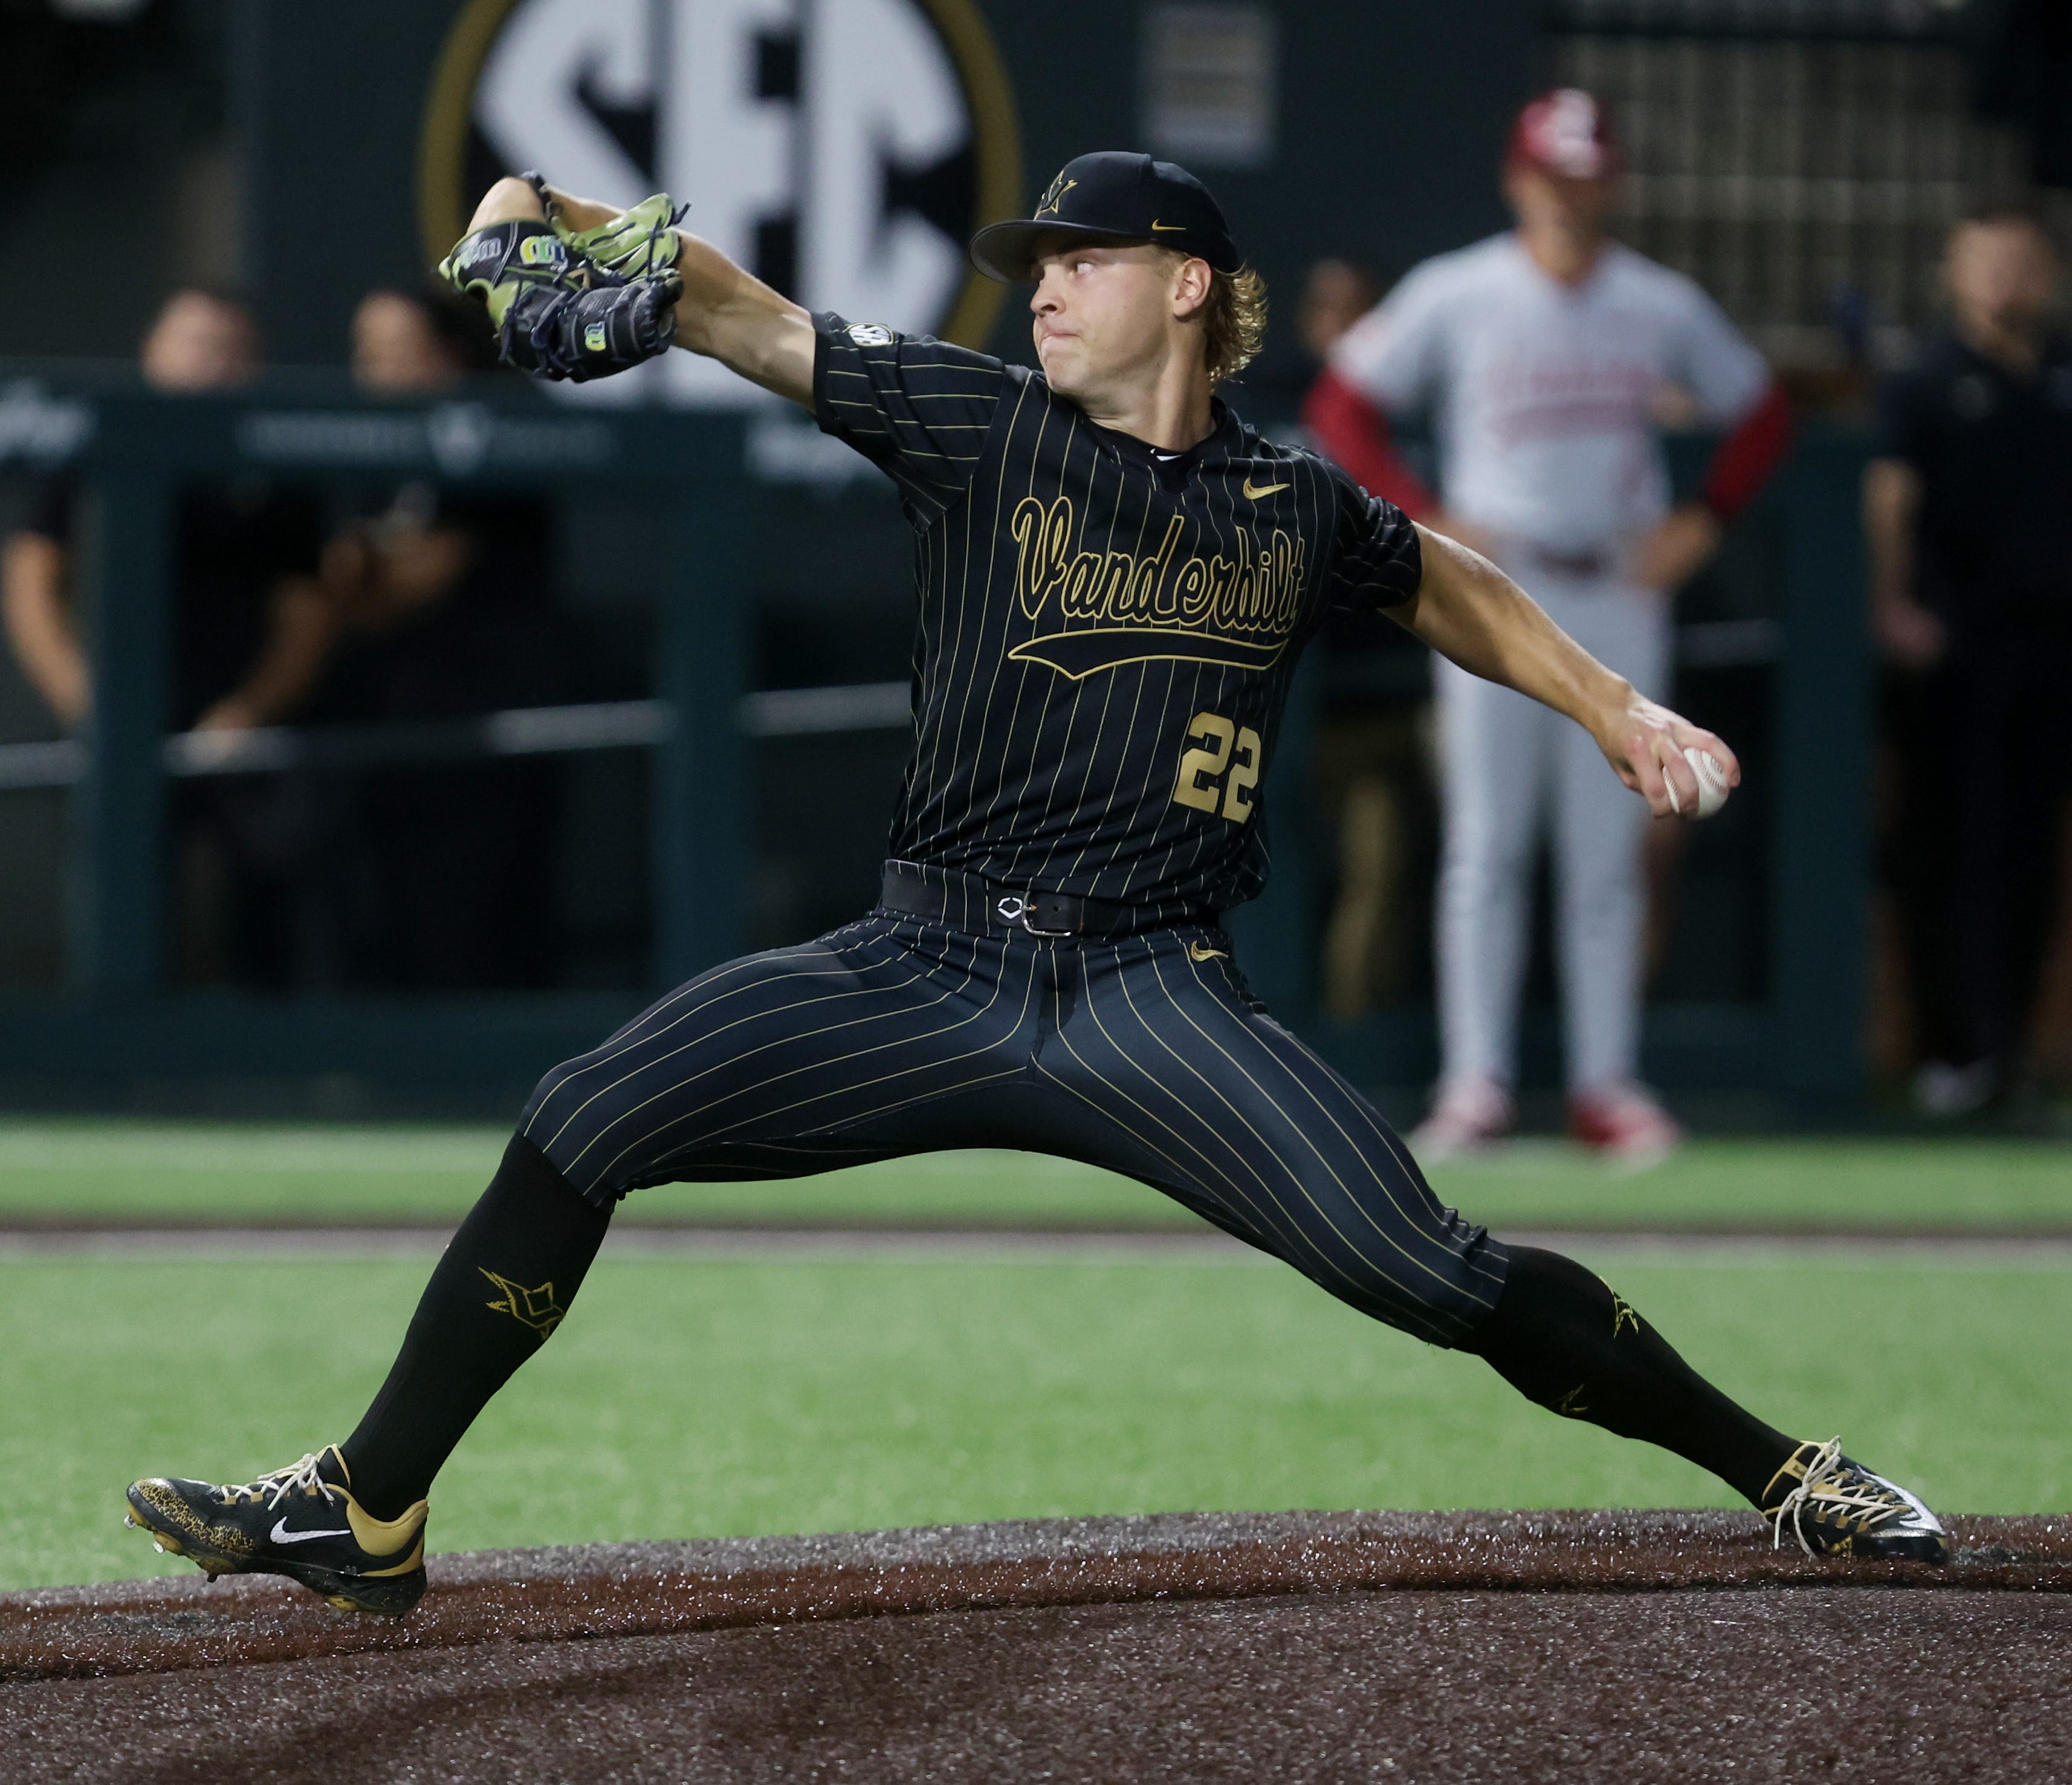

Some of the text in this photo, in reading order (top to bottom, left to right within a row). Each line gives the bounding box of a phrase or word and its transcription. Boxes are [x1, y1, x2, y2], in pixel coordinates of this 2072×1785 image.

[476, 0, 970, 406] SEC
[1011, 496, 1306, 633] Vanderbilt
[1173, 711, 1262, 824] 22
